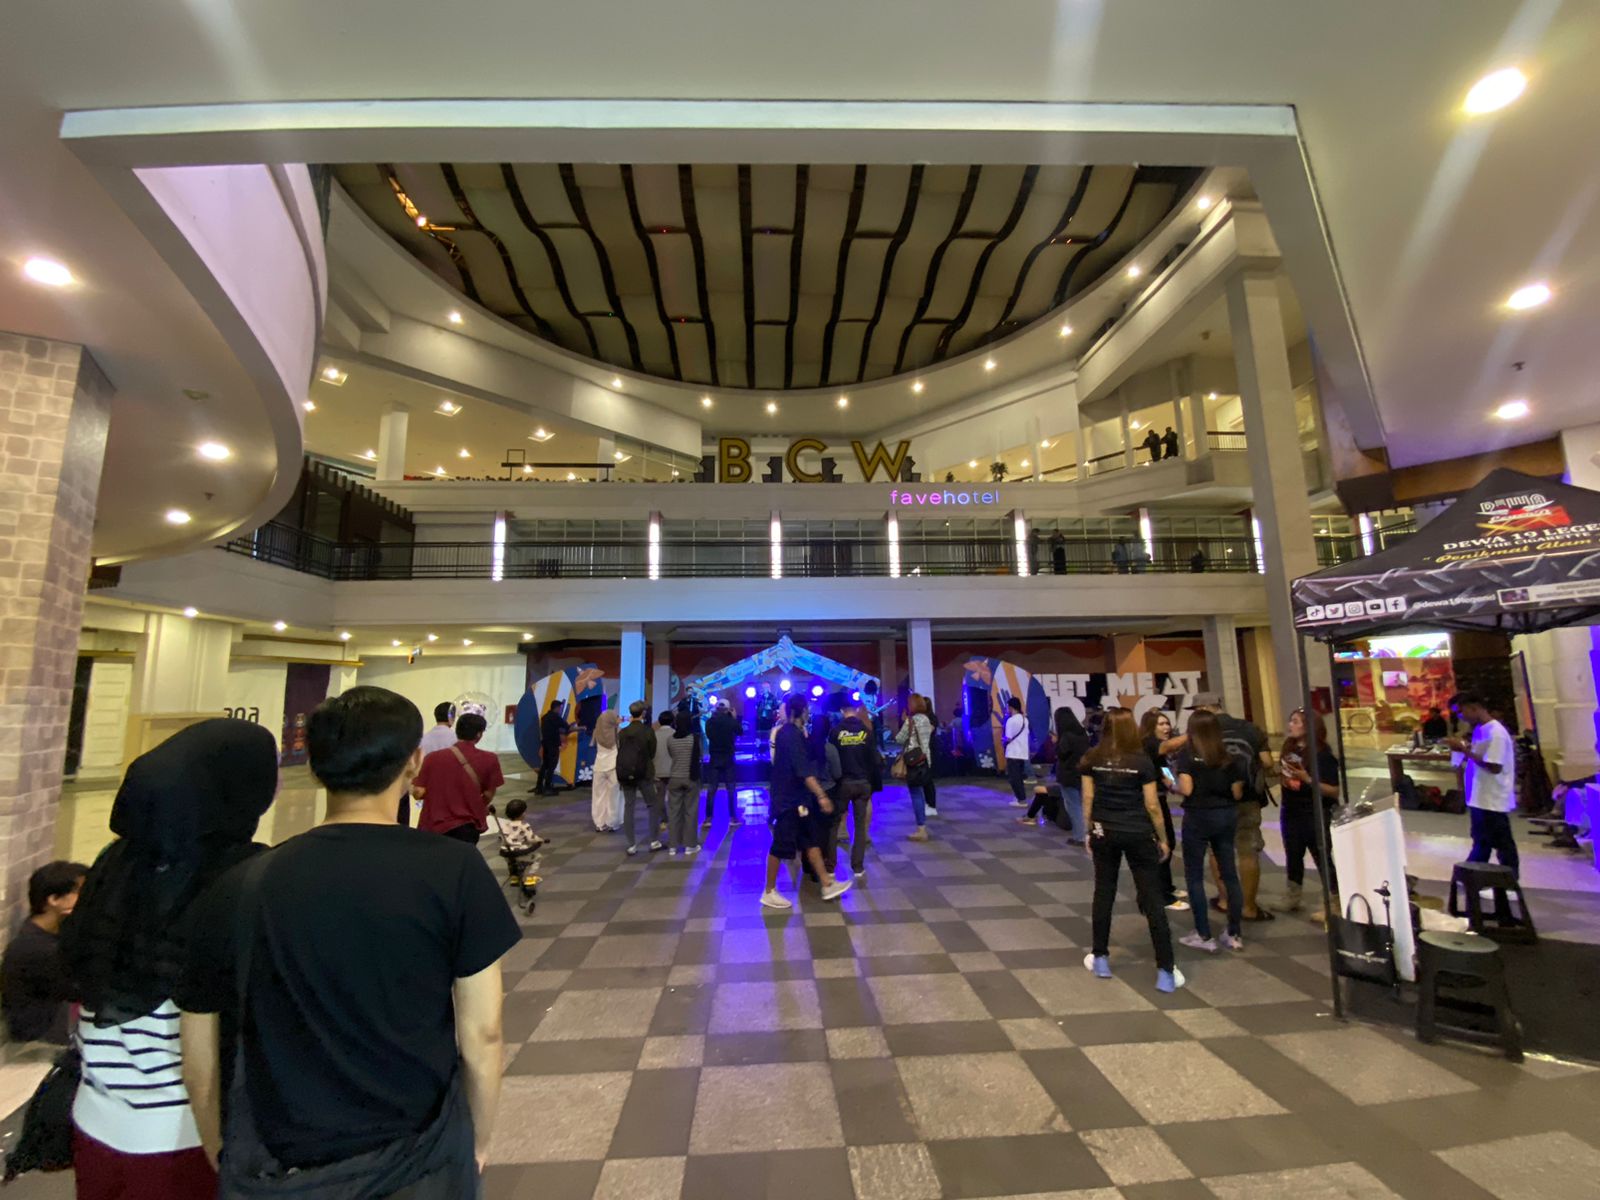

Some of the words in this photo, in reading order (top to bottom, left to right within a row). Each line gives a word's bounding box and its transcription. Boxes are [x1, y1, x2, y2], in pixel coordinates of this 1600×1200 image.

[890, 490, 999, 505] favehotel
[1443, 535, 1506, 550] DEWA
[1512, 531, 1538, 541] 19
[1485, 541, 1512, 549] THE
[1106, 672, 1155, 696] ME
[1163, 671, 1202, 695] AT
